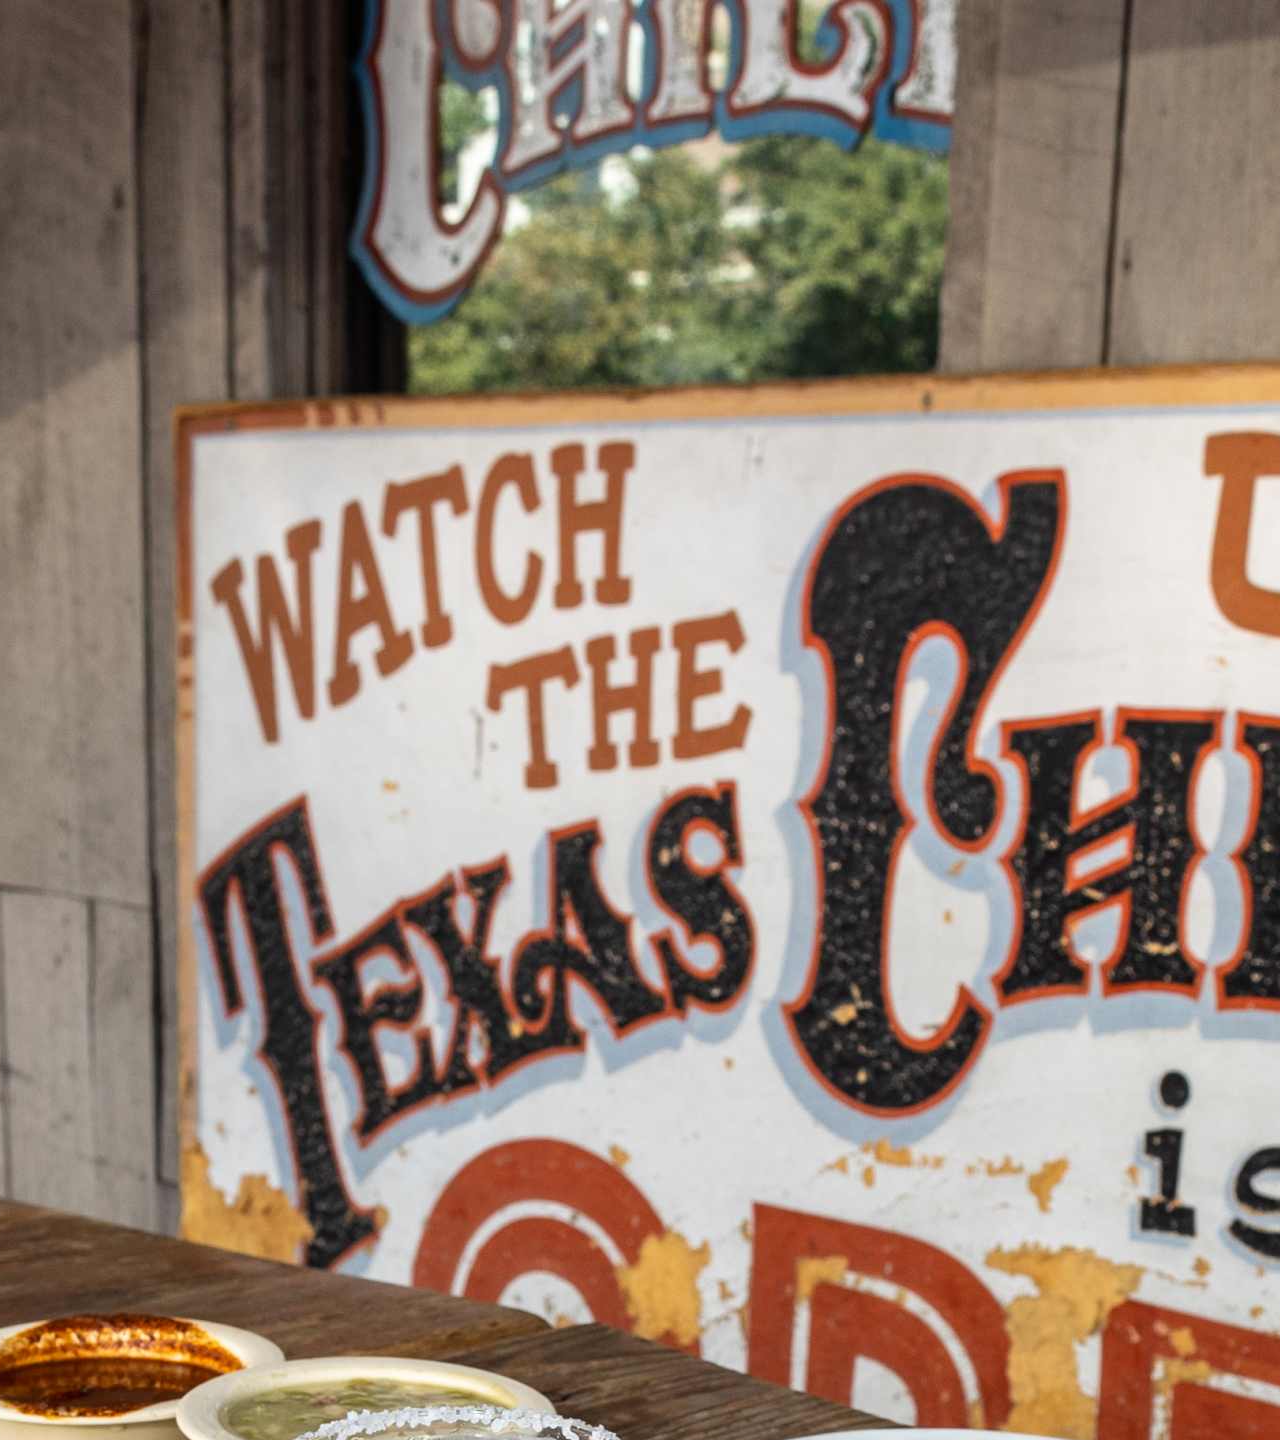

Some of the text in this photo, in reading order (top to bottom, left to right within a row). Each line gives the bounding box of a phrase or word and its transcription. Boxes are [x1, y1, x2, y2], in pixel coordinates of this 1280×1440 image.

[210, 440, 636, 747] WATCH
[486, 608, 754, 790] THE
[196, 778, 758, 1274] TEXAS
